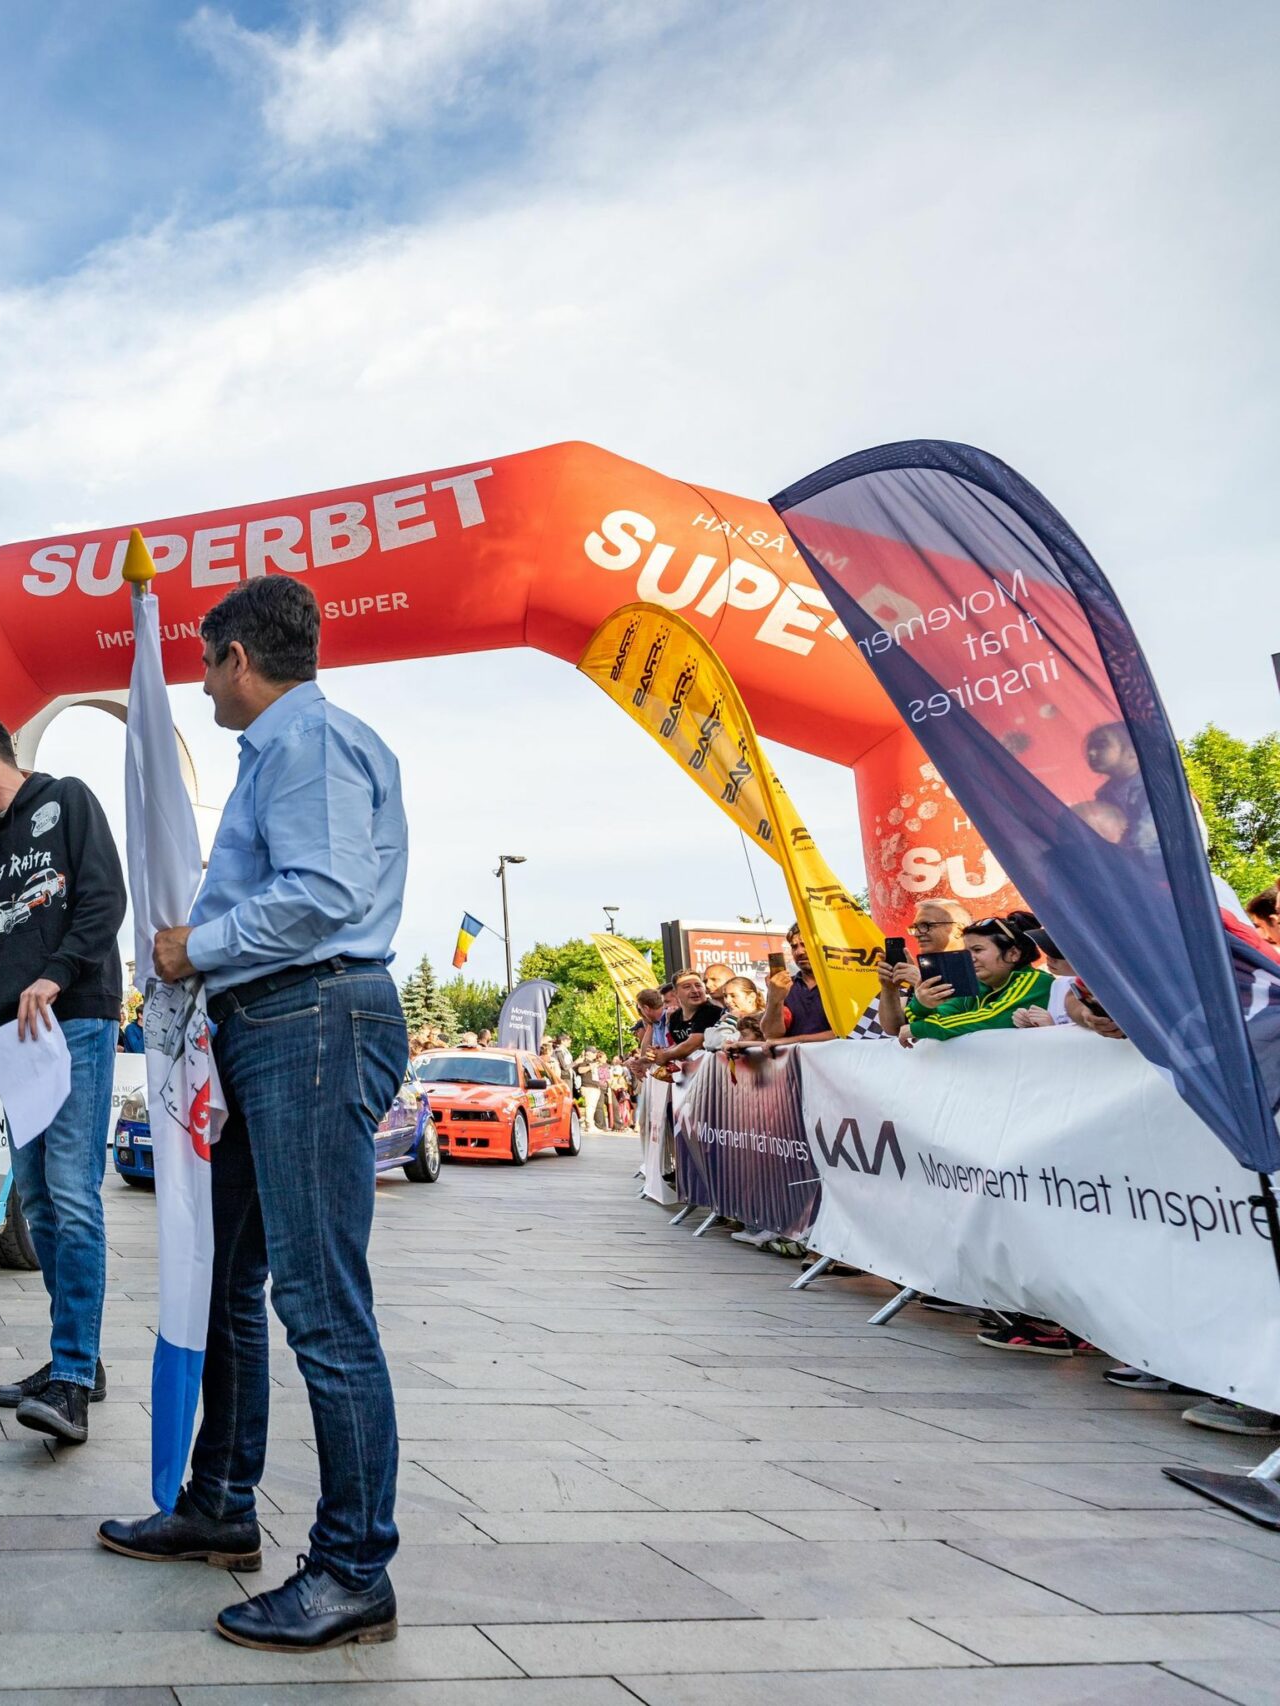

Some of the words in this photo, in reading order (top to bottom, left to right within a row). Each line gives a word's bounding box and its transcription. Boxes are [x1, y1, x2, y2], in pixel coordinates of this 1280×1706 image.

[22, 466, 494, 597] SUPERBET
[691, 512, 745, 540] HAI
[746, 530, 790, 553] SĂ
[323, 591, 410, 621] SUPER
[694, 949, 753, 965] TROFEUL
[822, 944, 887, 967] FRA
[697, 1120, 749, 1150] Movement
[749, 1127, 768, 1154] that
[769, 1130, 810, 1164] inspires
[917, 1151, 1030, 1203] Movement
[1039, 1166, 1112, 1217] that
[1124, 1175, 1272, 1243] inspire
